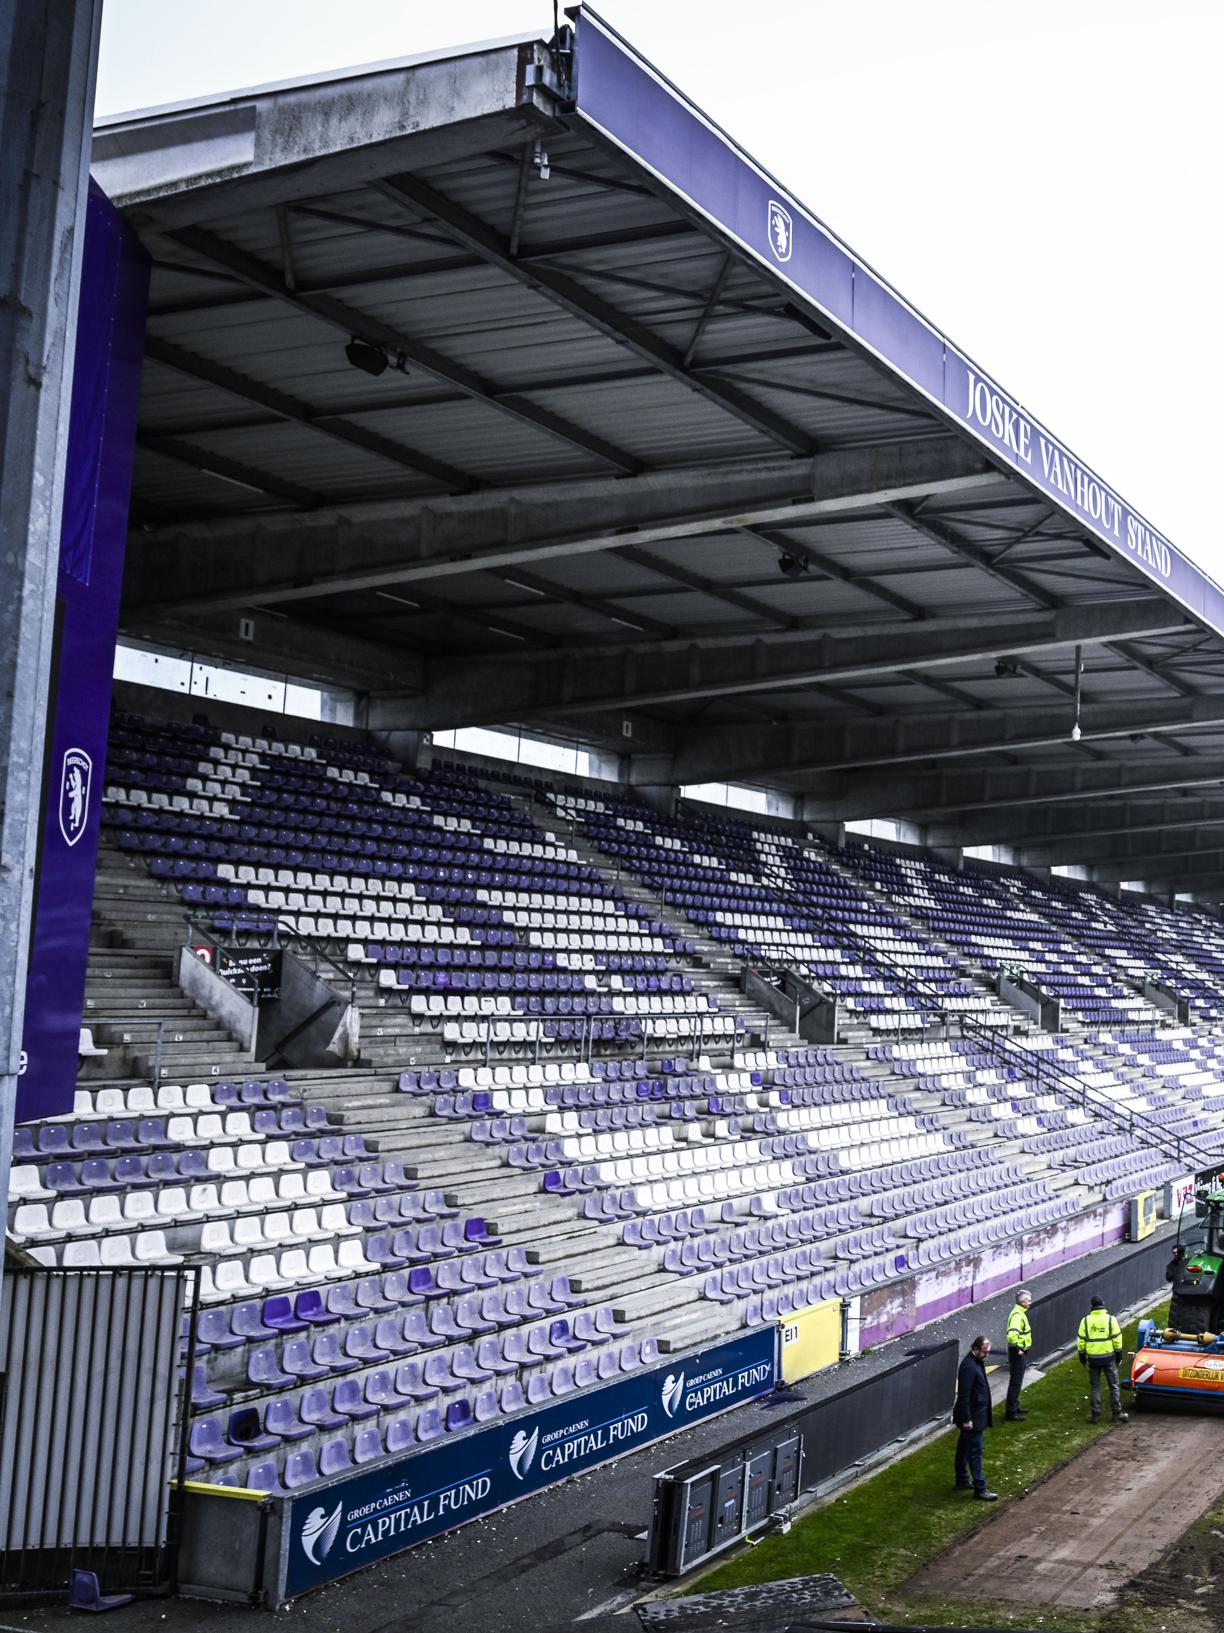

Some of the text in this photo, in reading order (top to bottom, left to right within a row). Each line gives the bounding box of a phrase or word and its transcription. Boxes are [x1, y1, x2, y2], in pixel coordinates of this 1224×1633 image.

[966, 370, 1171, 578] JOSKE VANHOUT STAND
[685, 1364, 769, 1411] CAPITAL FUND
[541, 1419, 589, 1444] GROEP CAENEN
[541, 1413, 648, 1471] CAPITAL FUND
[345, 1477, 491, 1553] CAPITAL FUND
[347, 1489, 412, 1521] GROEP CAENEN
